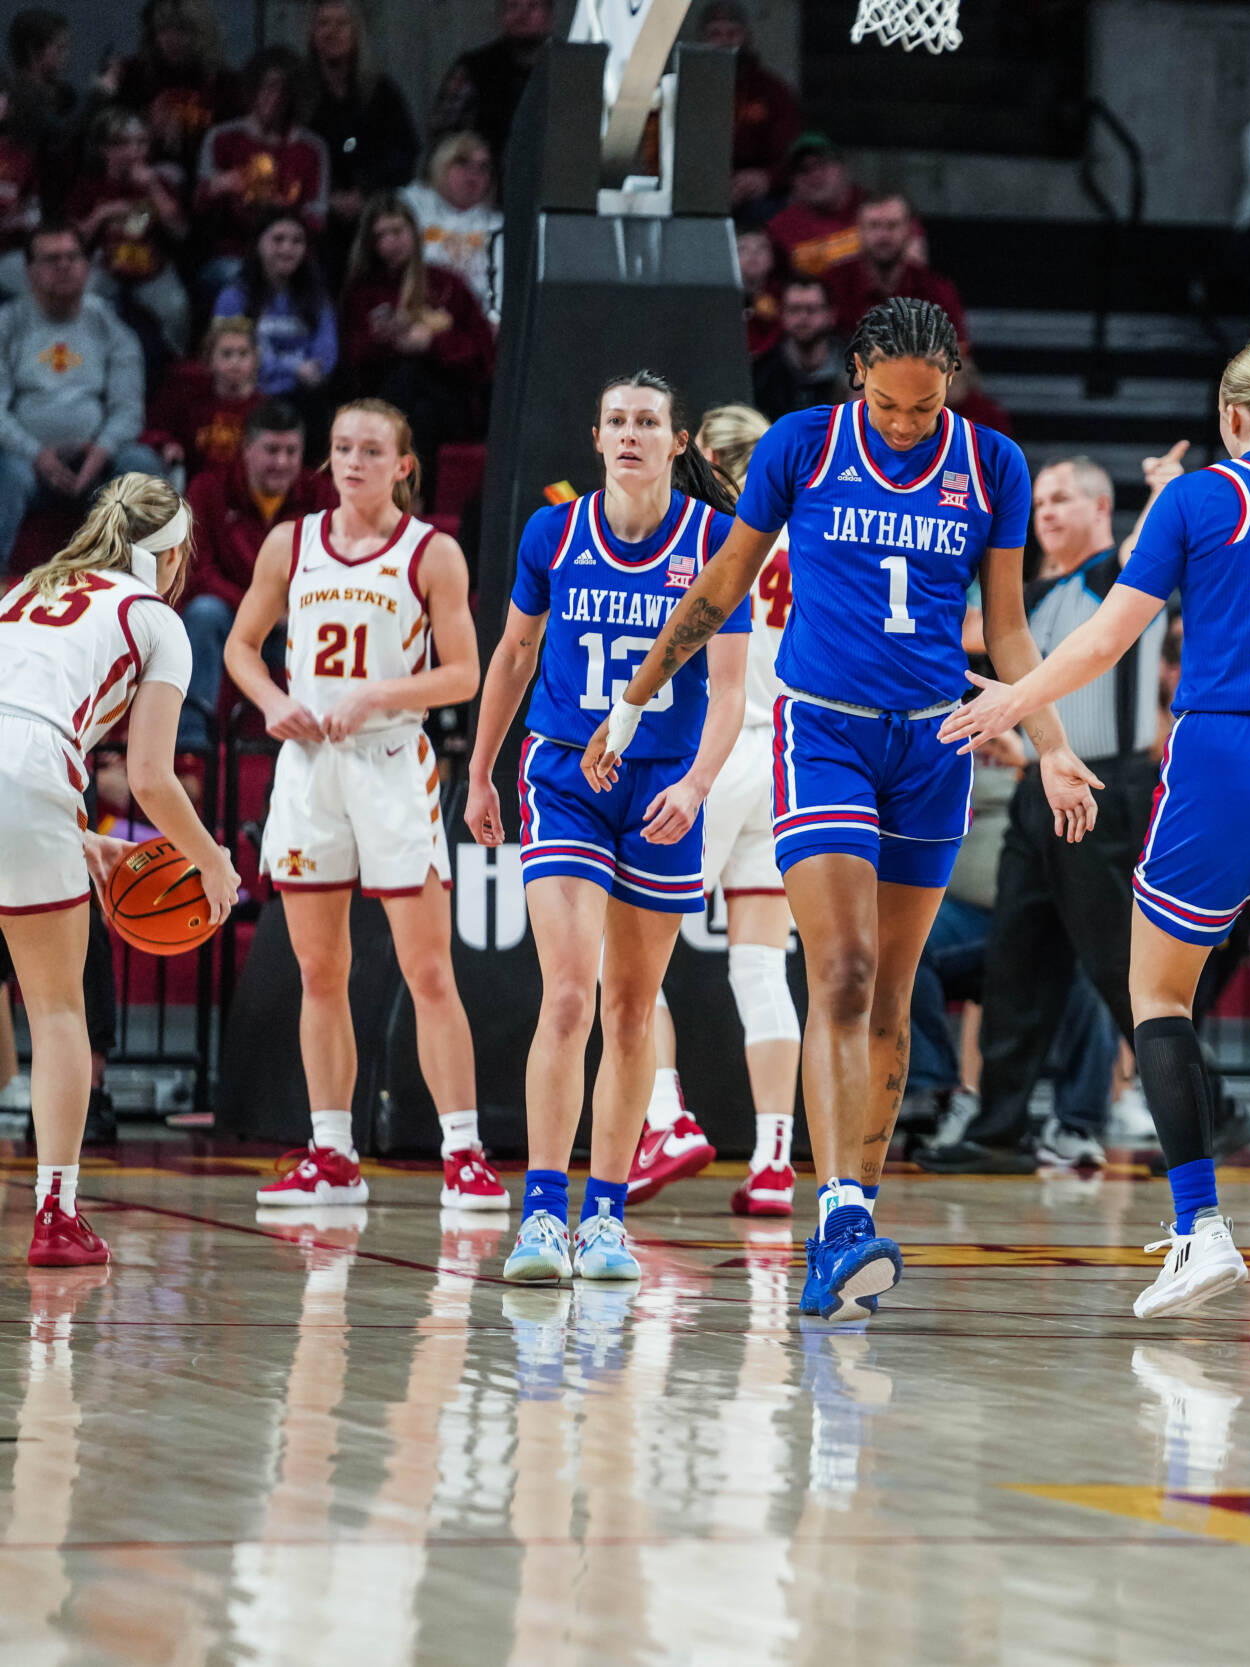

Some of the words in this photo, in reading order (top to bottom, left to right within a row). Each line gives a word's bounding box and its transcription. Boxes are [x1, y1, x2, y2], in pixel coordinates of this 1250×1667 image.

[837, 473, 862, 482] adidas
[823, 506, 969, 556] JAYHAWKS
[300, 588, 341, 609] IOWA
[343, 587, 398, 614] STATE
[751, 548, 793, 629] 4
[879, 556, 916, 634] 1
[314, 622, 368, 679] 21
[579, 632, 674, 712] 13
[126, 842, 176, 872] ELIT
